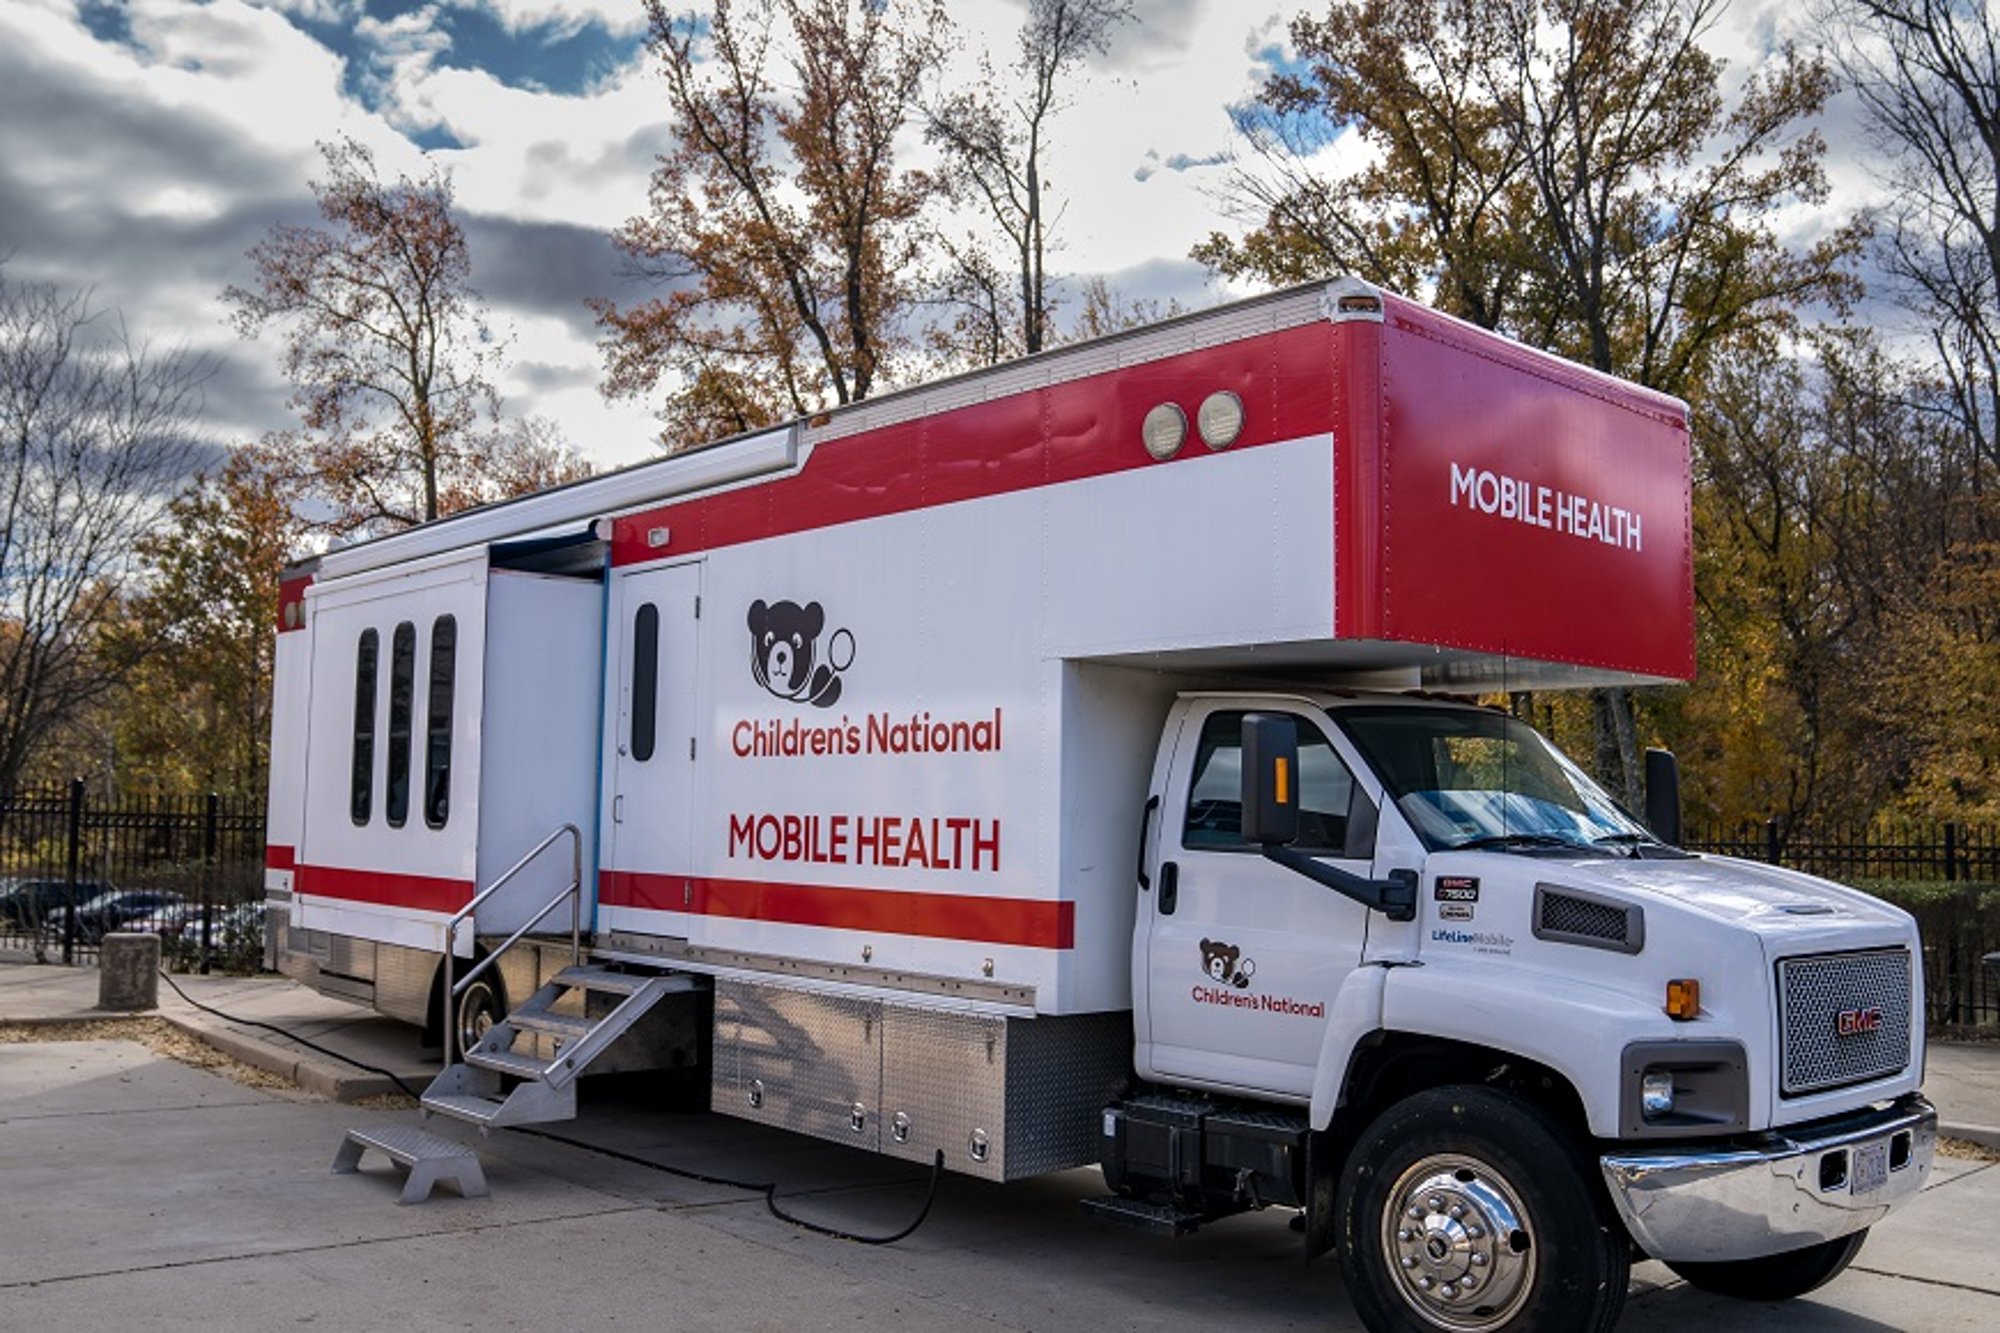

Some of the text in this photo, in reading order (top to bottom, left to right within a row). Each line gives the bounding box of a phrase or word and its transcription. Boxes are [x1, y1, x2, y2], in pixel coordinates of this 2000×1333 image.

[1450, 461, 1642, 552] MOBILE HEALTH
[732, 707, 1002, 757] Children's National
[728, 813, 1001, 872] MOBILE HEALTH
[1443, 879, 1472, 887] GMC
[1192, 985, 1326, 1018] Children's National
[1838, 1006, 1881, 1035] GMC
